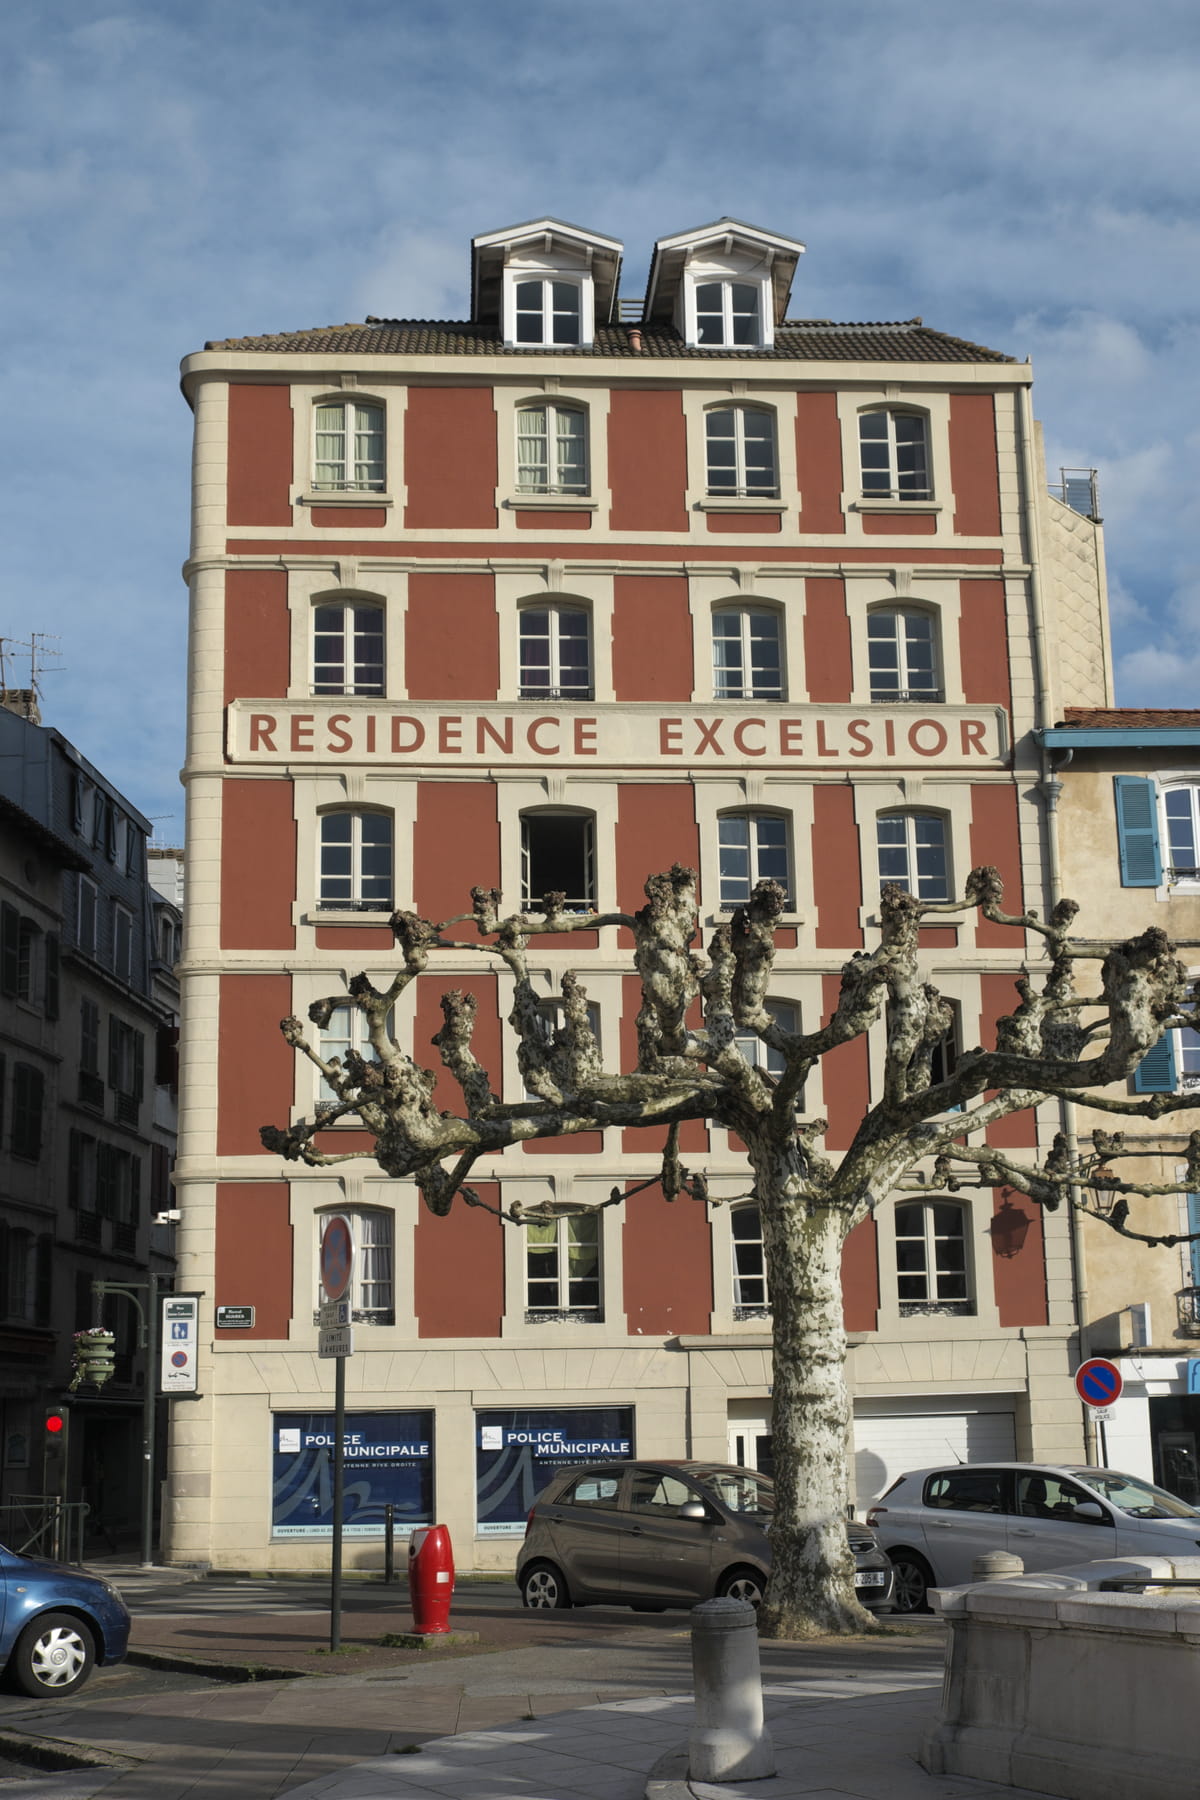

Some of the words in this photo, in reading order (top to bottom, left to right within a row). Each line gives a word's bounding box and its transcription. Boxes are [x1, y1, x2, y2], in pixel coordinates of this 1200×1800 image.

[248, 713, 598, 756] RESIDENCE
[658, 717, 988, 757] EXCELSIOR
[305, 1434, 361, 1446] POLCE
[507, 1432, 562, 1443] POLICE
[537, 1443, 630, 1454] MUNICIPALE
